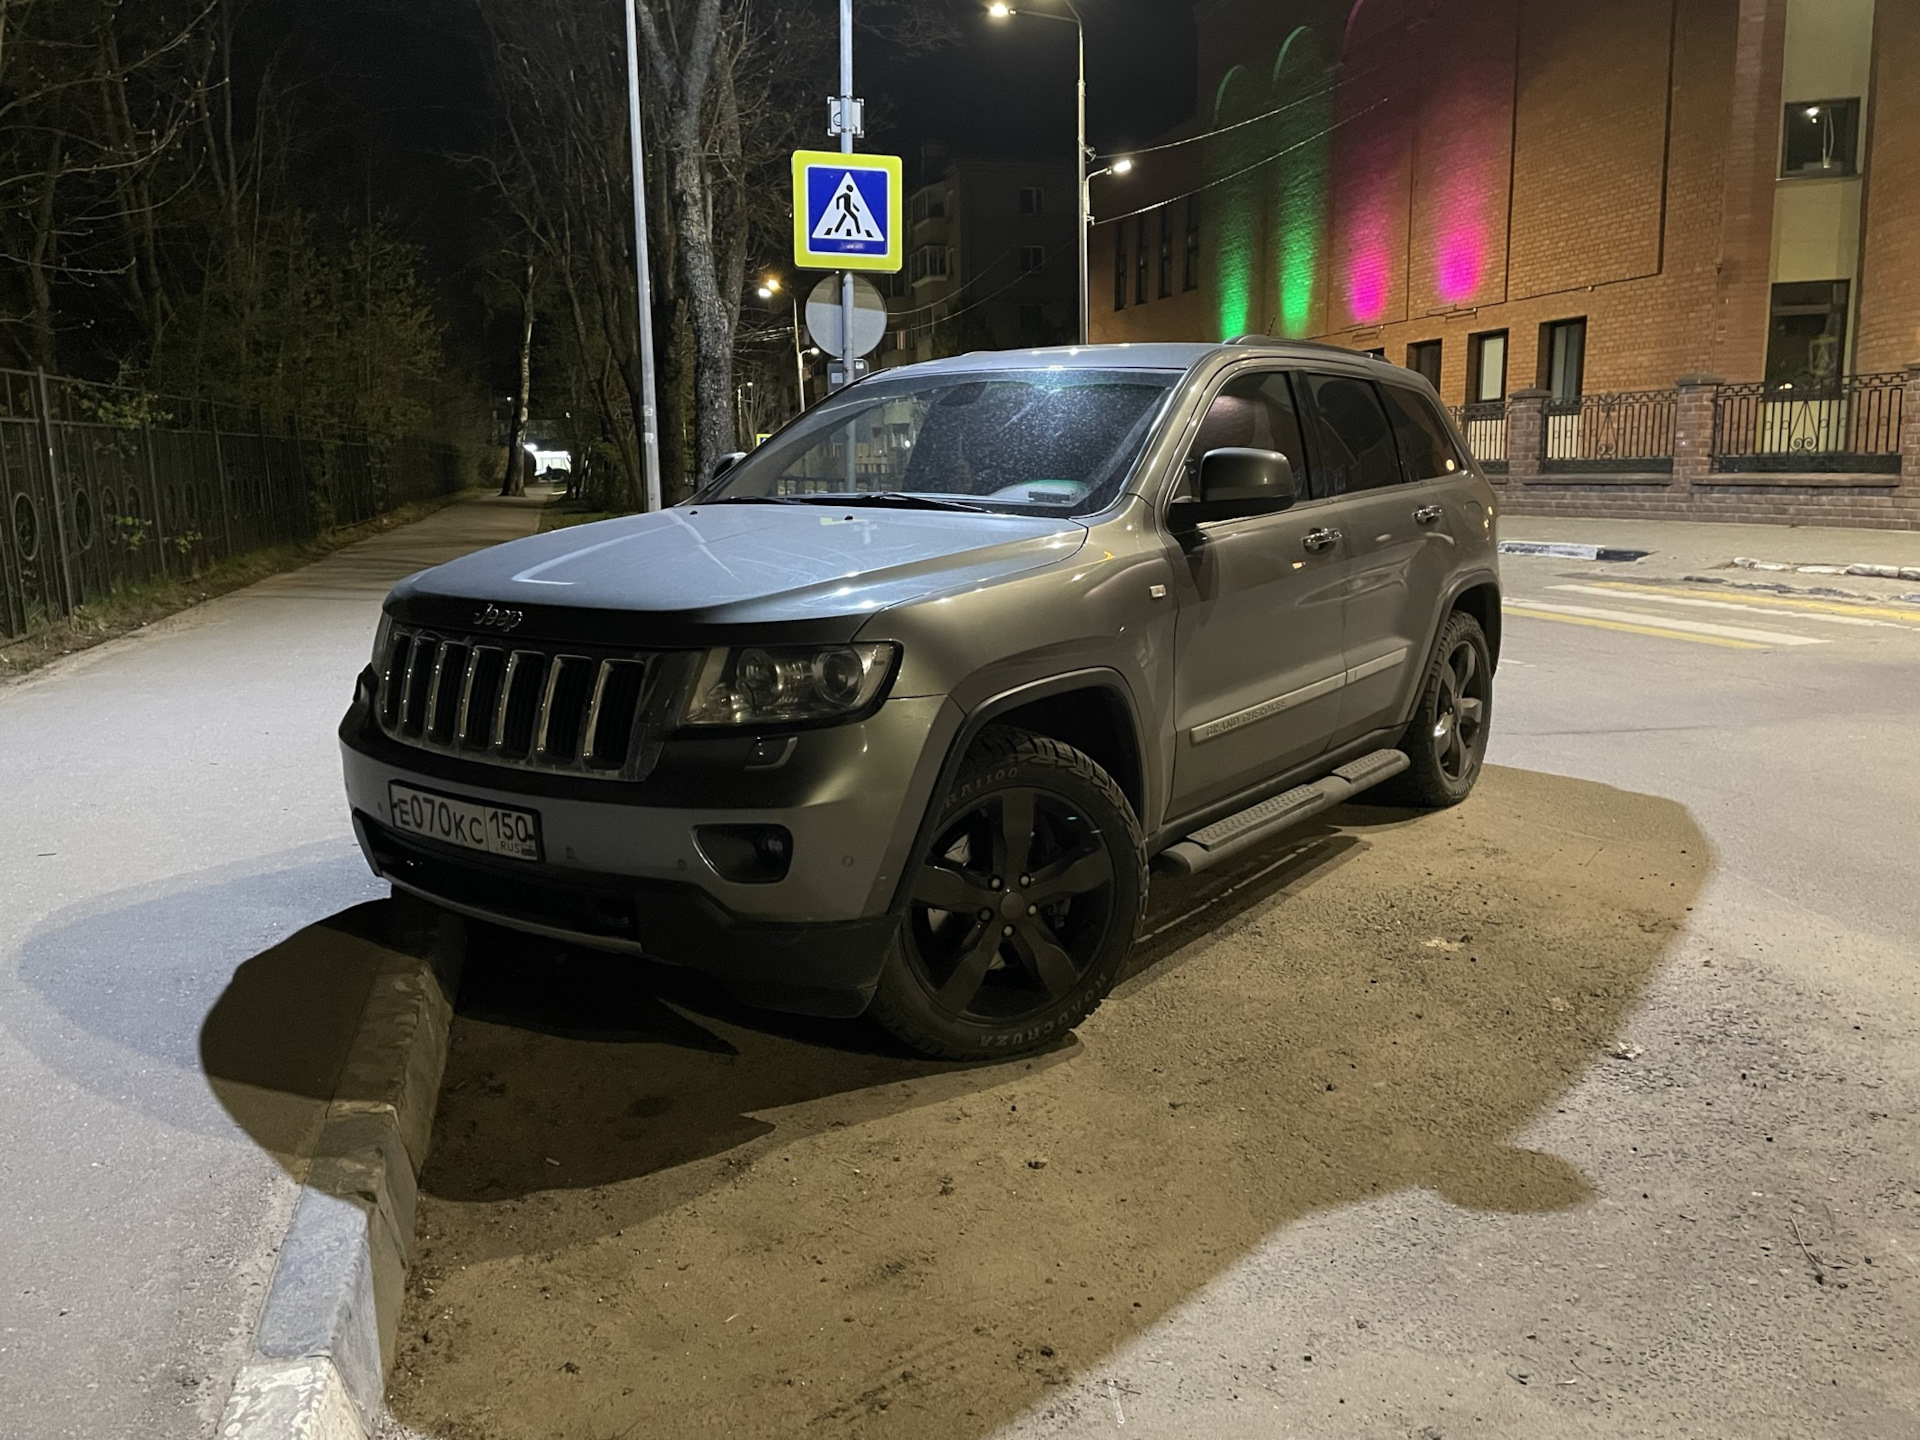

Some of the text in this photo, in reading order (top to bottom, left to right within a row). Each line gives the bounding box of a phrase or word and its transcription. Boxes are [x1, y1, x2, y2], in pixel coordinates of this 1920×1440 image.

[473, 603, 523, 632] Jeep
[1206, 716, 1240, 736] GRAND
[489, 811, 528, 843] 150
[501, 840, 521, 854] RUS
